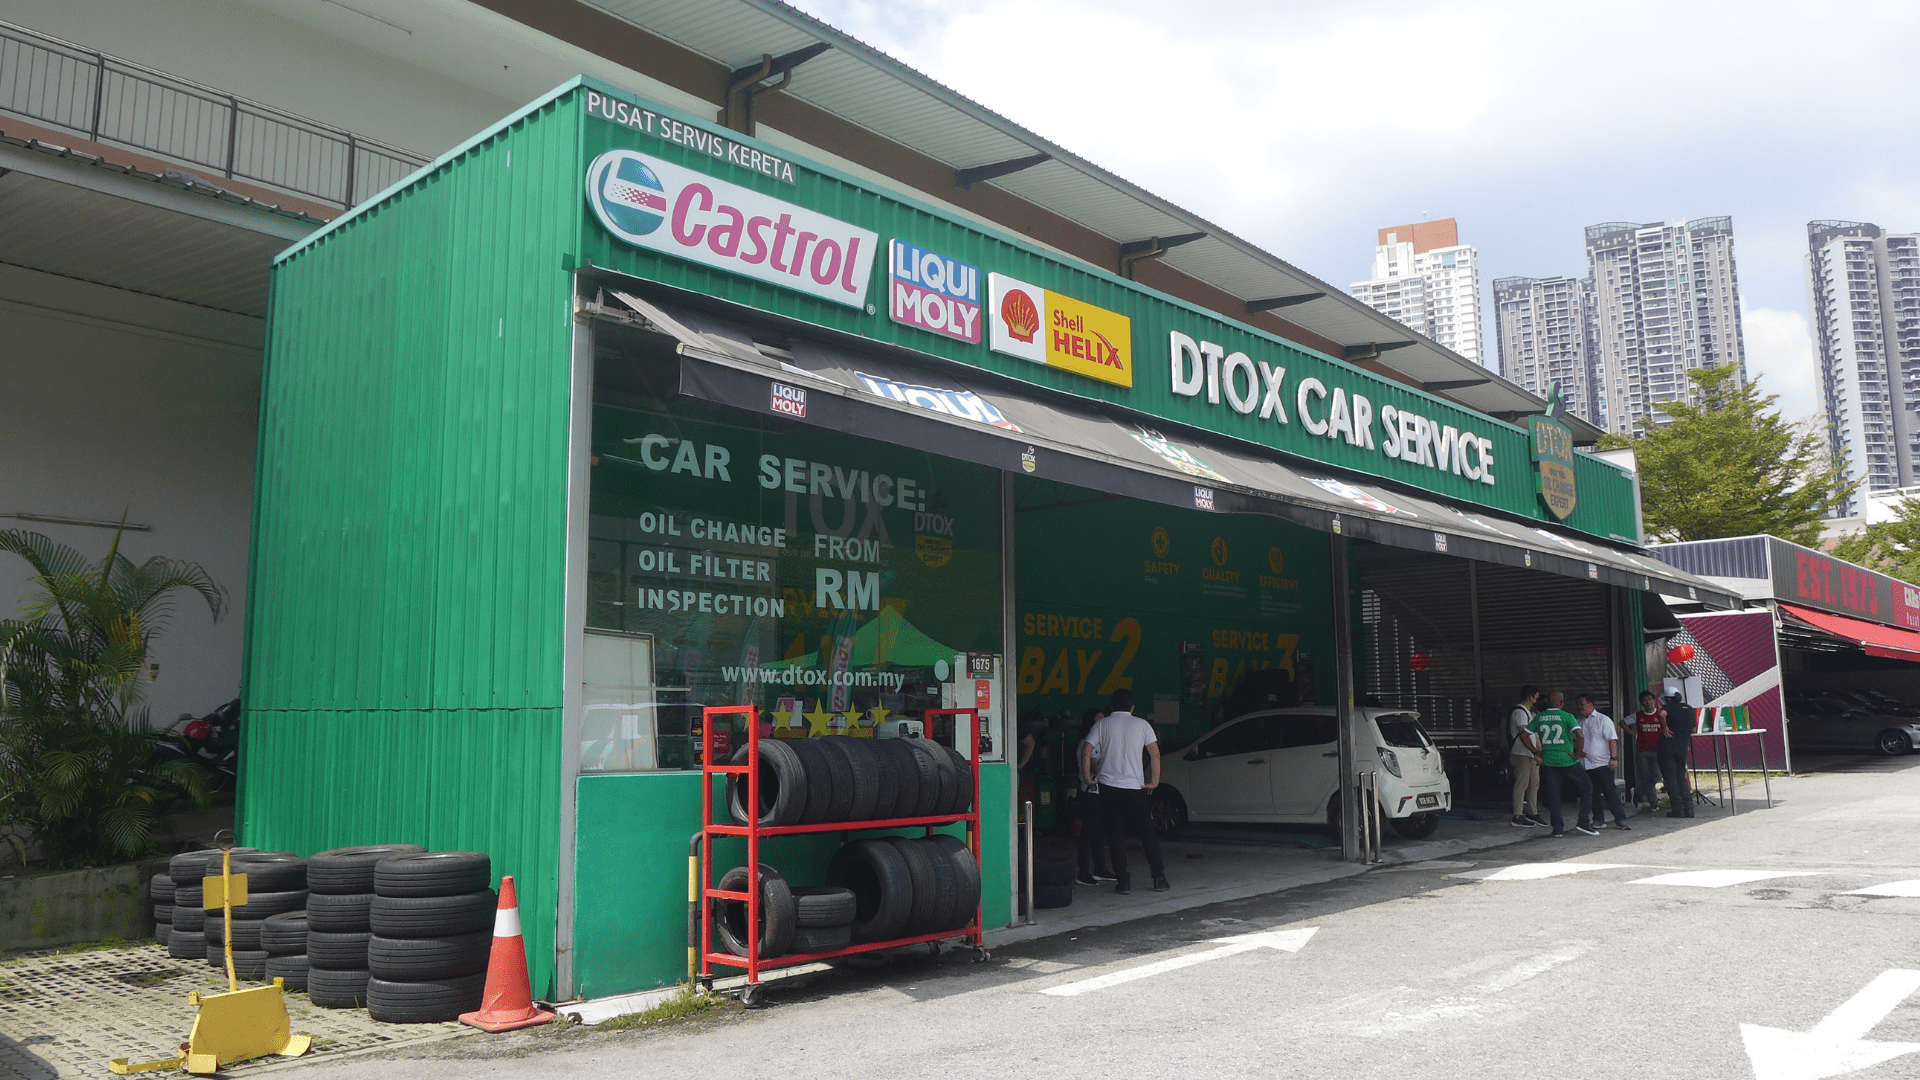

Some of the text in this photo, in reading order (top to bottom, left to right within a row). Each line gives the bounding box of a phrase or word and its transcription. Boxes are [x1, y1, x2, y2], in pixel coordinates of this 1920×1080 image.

[588, 91, 794, 183] PUSAT SERVIS KERETA
[671, 182, 860, 294] Castrol
[896, 242, 976, 301] LIQUI
[896, 283, 979, 338] MOLY
[1053, 309, 1083, 333] Shell
[1053, 328, 1124, 370] HELIX
[772, 397, 804, 415] MOLY
[773, 384, 804, 403] LIQUI
[1170, 330, 1496, 486] DTOX CAR SERVICE
[1536, 421, 1574, 466] DTOX
[640, 433, 926, 513] CAR SERVICE:
[1195, 486, 1214, 500] LIQUI
[1195, 497, 1214, 509] MOLY
[639, 512, 786, 548] OIL CHANGE
[914, 511, 954, 537] DTOX
[814, 533, 880, 563] FROM
[638, 550, 771, 582] OIL FILTER
[1144, 560, 1181, 576] SAFETY
[1202, 567, 1240, 584] QUALITY
[1796, 550, 1837, 605] EST.
[816, 568, 880, 611] RM
[1258, 575, 1299, 590] EFFICIENT
[638, 587, 785, 618] INSPECTION
[1023, 612, 1102, 639] SERVICE
[1212, 629, 1269, 651] SERVICE
[971, 658, 990, 670] 1675
[1016, 616, 1142, 695] BAY 2
[721, 662, 905, 694] www.dtox.com.my
[1539, 714, 1562, 722] CASTROL
[1539, 724, 1565, 744] 22
